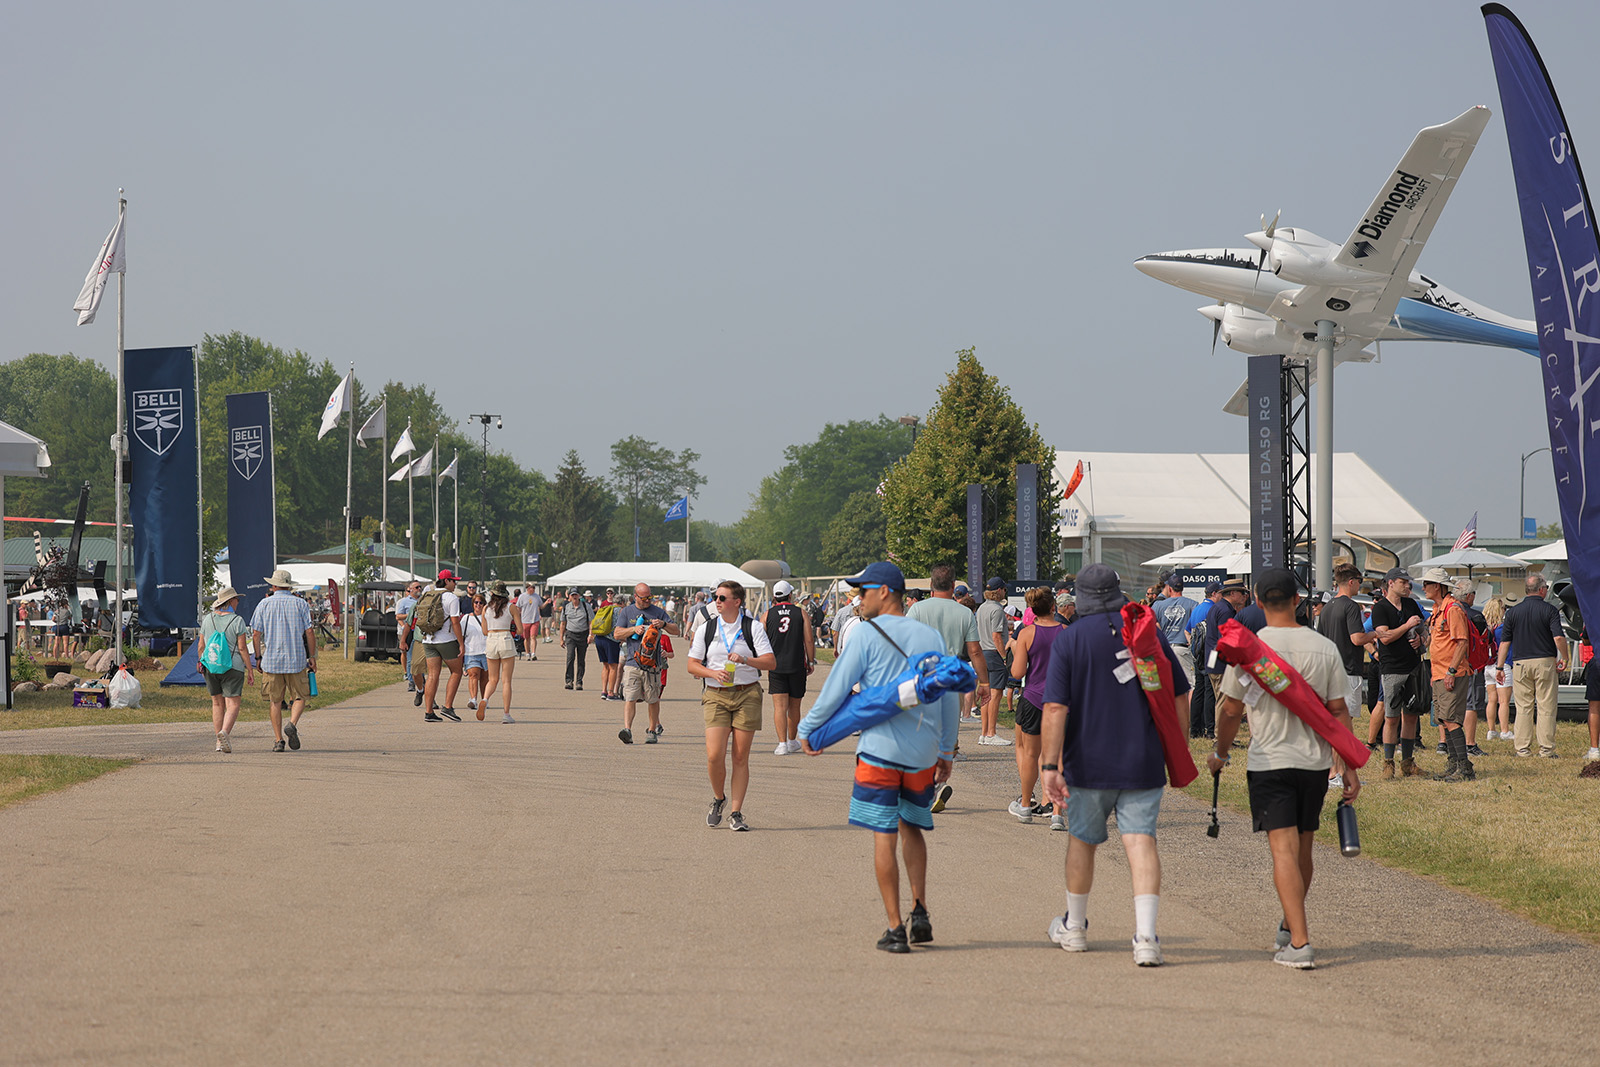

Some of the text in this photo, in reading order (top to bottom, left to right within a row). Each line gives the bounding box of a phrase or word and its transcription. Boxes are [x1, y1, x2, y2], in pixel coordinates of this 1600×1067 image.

[1404, 178, 1431, 211] AIRCRAFT
[1357, 169, 1420, 241] Diamond
[1535, 265, 1570, 484] AIRCRAFT
[137, 393, 178, 407] BELL
[234, 429, 260, 441] BELL
[1259, 396, 1273, 567] MEET THE DA50 RG
[1023, 487, 1031, 501] RG
[971, 503, 978, 516] RG
[1023, 504, 1031, 532] DA50
[1023, 535, 1031, 555] THE
[1182, 575, 1220, 583] DA50 RG
[778, 616, 791, 633] 3
